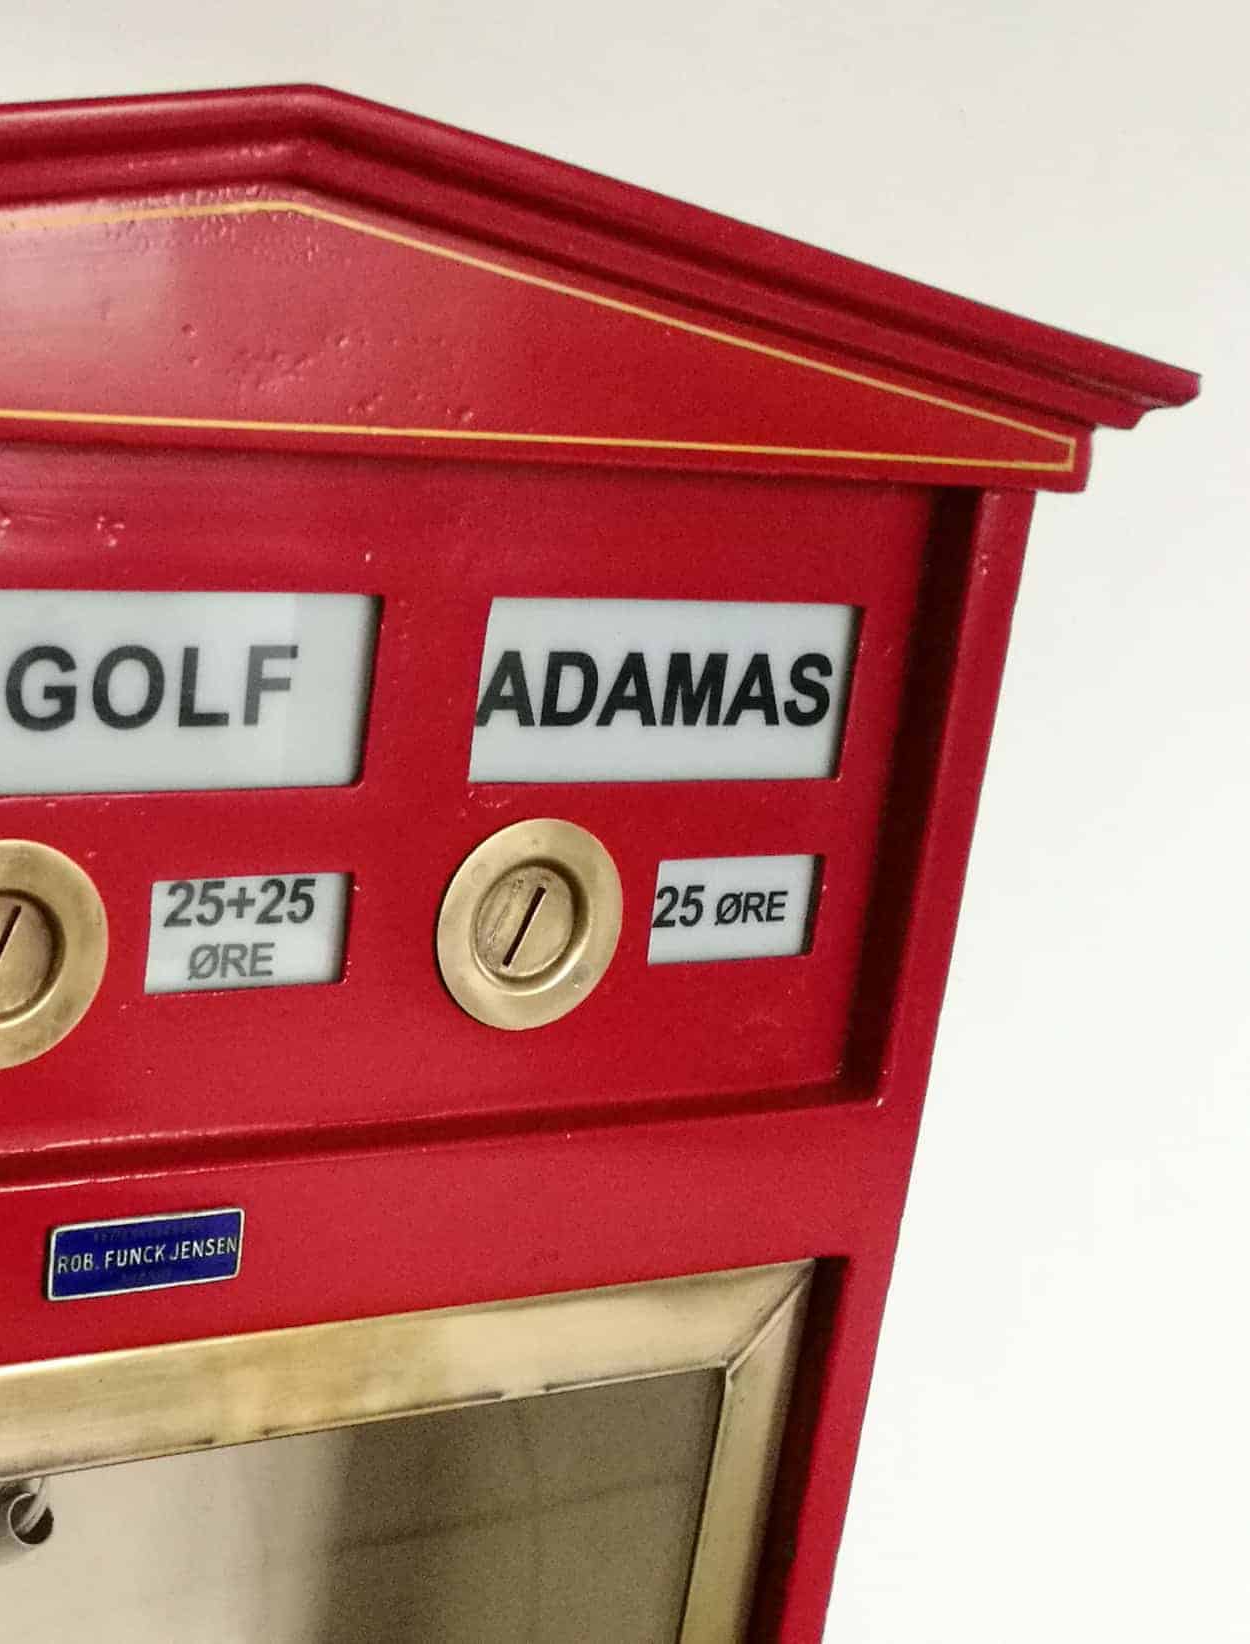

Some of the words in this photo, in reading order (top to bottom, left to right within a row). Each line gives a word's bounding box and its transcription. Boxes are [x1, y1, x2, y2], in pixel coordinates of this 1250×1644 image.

[5, 645, 299, 732] GOLF
[474, 650, 833, 728] ADAMAS
[163, 877, 316, 929] 25+25
[652, 885, 705, 929] 25
[714, 890, 789, 926] ØRE
[187, 941, 276, 981] ØRE
[57, 1252, 100, 1275] ROB.
[104, 1243, 167, 1270] FUNCK
[169, 1236, 238, 1262] JENSEN
